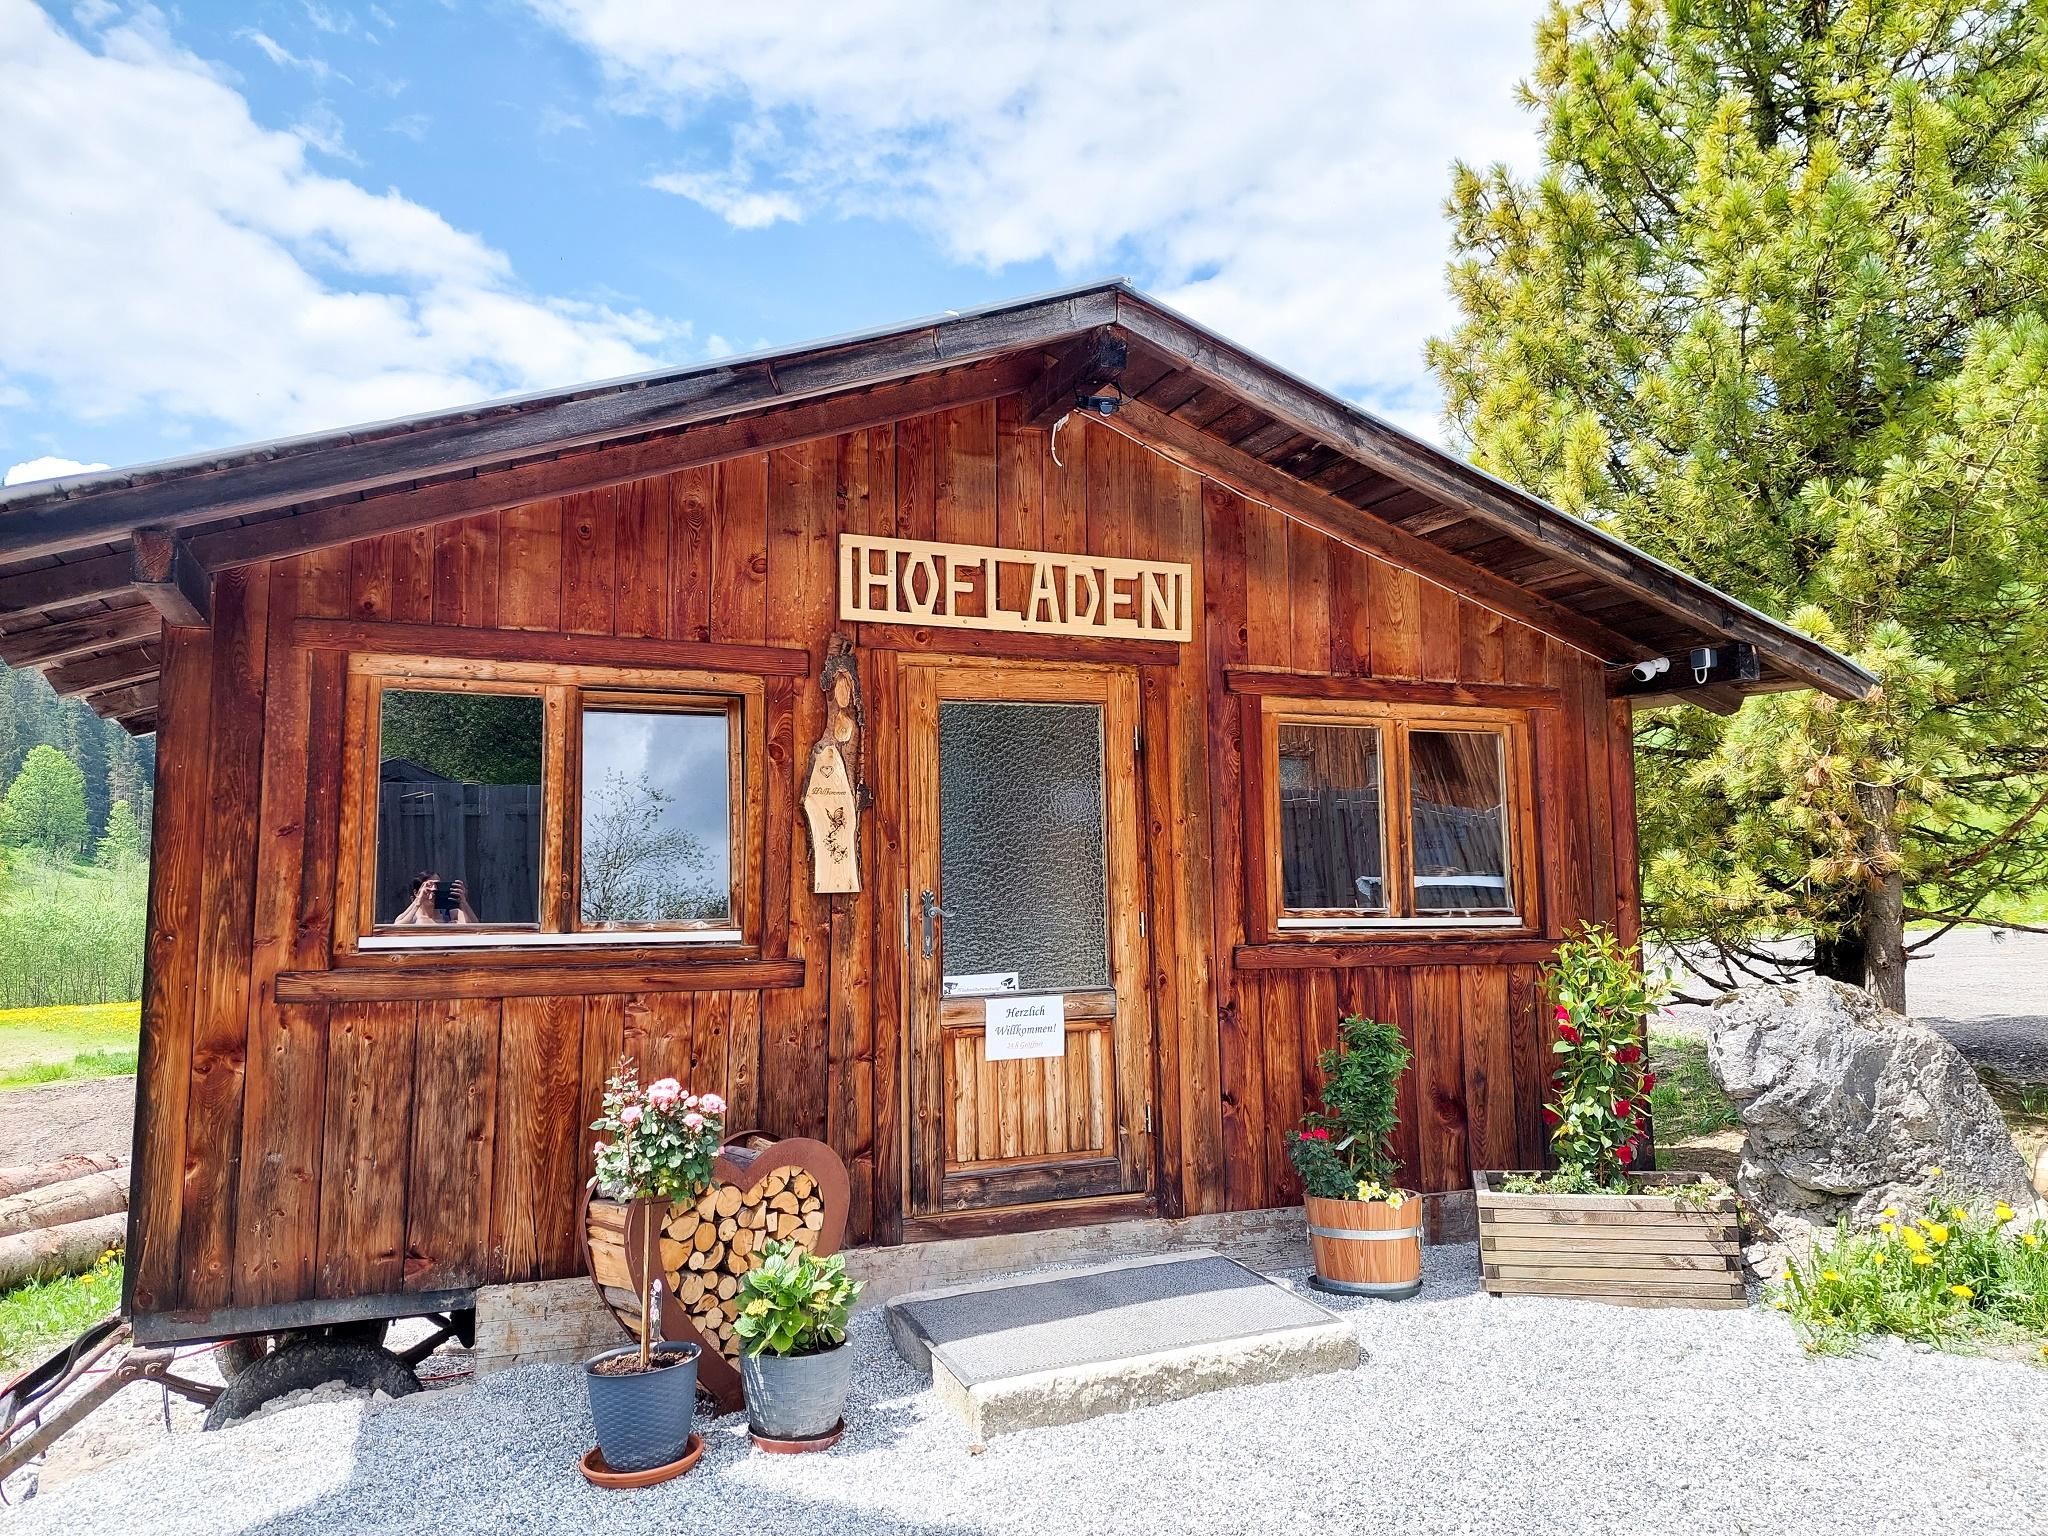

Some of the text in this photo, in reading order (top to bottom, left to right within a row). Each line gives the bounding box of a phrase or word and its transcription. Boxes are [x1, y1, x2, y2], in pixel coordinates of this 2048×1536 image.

[860, 545, 1177, 631] HOFLADEN
[1005, 1004, 1046, 1019] Herzlich
[994, 1023, 1057, 1038] Willkommen!
